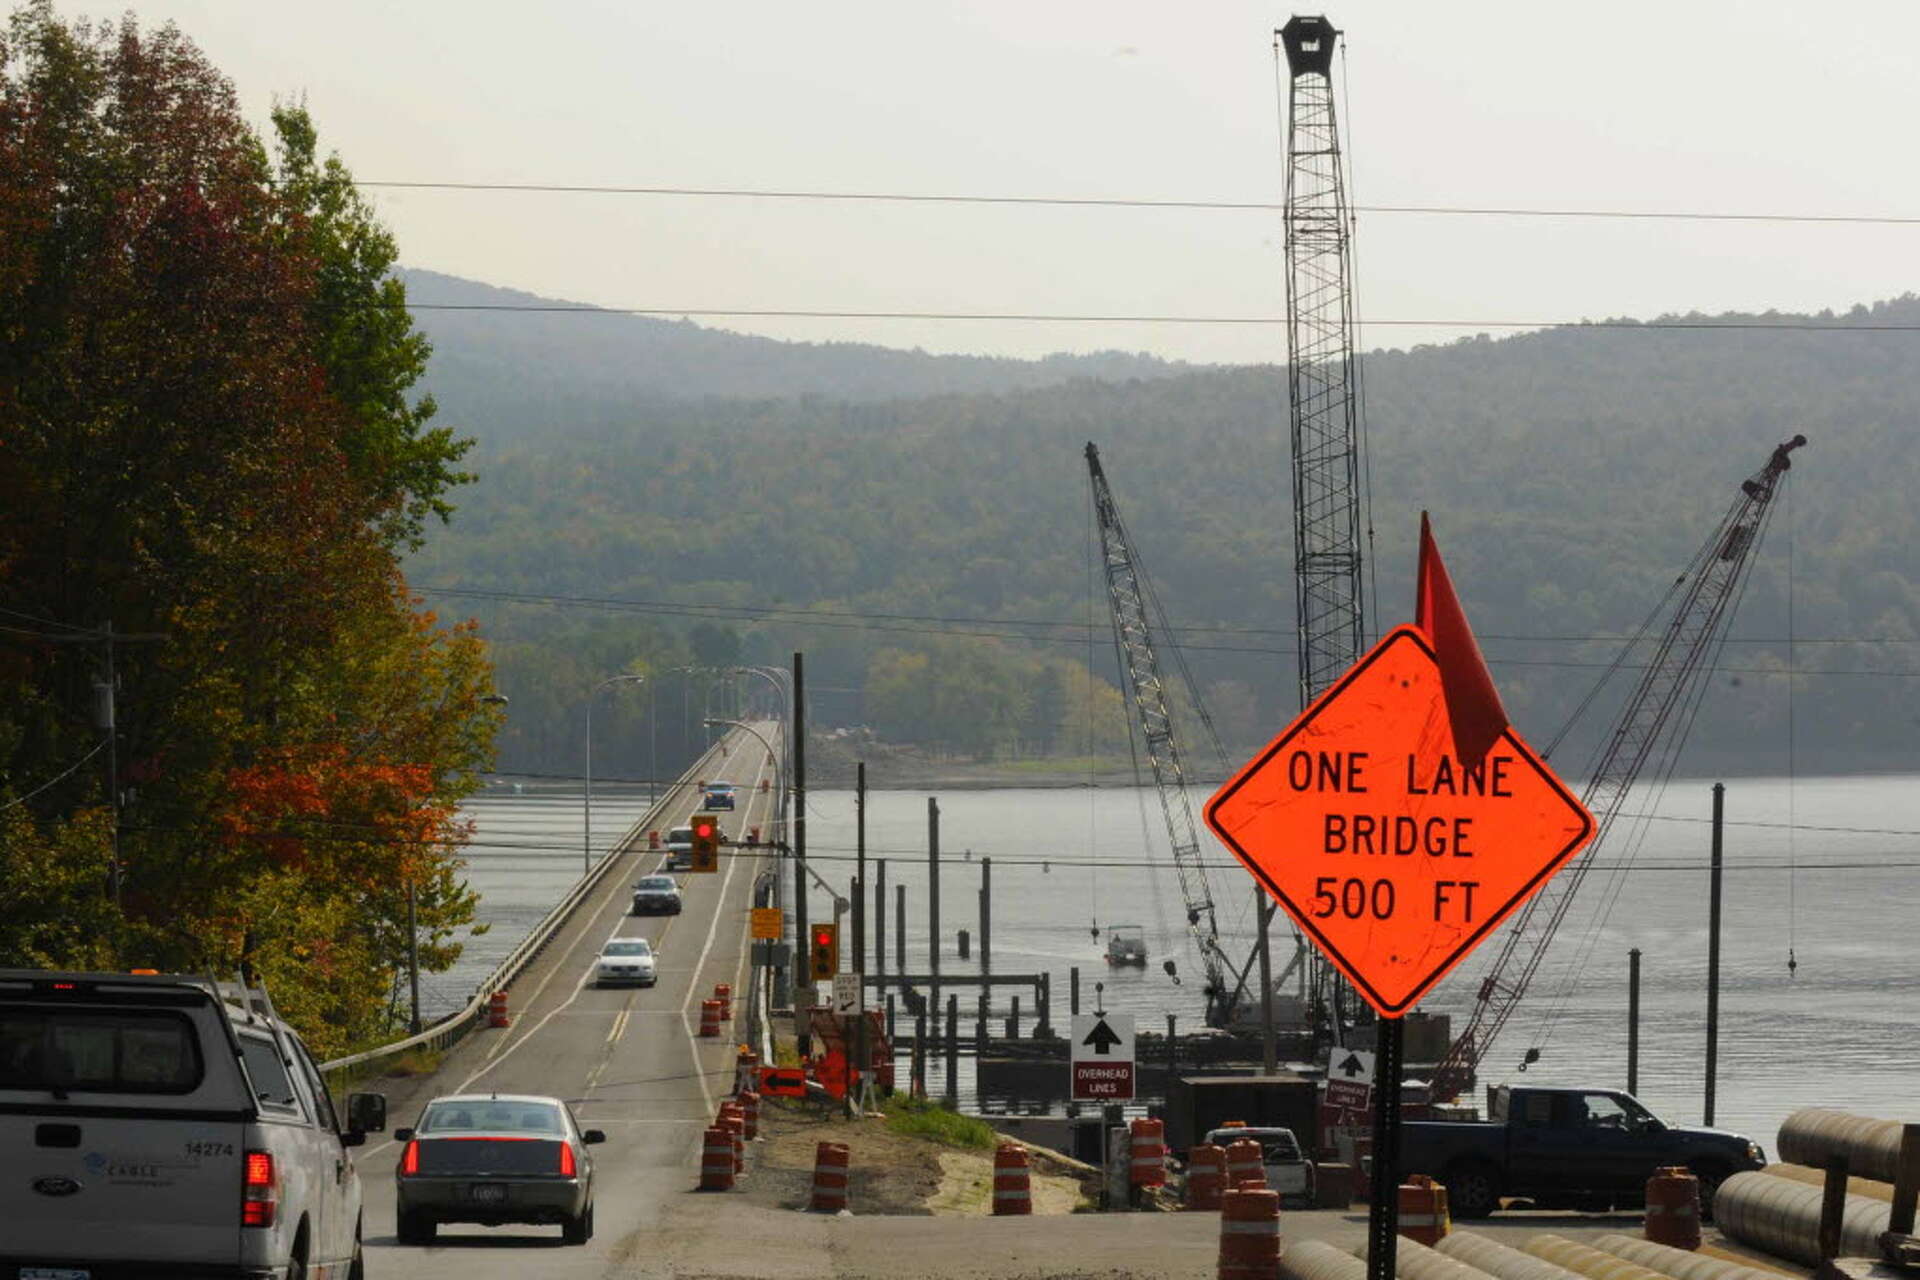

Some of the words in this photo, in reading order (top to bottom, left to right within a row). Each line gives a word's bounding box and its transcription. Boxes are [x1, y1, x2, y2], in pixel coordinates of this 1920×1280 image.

[1288, 751, 1368, 793] ONE
[1407, 753, 1513, 797] LANE
[1324, 814, 1473, 858] BRIDGE
[1314, 877, 1395, 920] 500
[1433, 880, 1480, 923] FT
[1078, 1068, 1129, 1080] OVERHEAD
[1088, 1083, 1117, 1094] LINES
[184, 1143, 234, 1157] 14274
